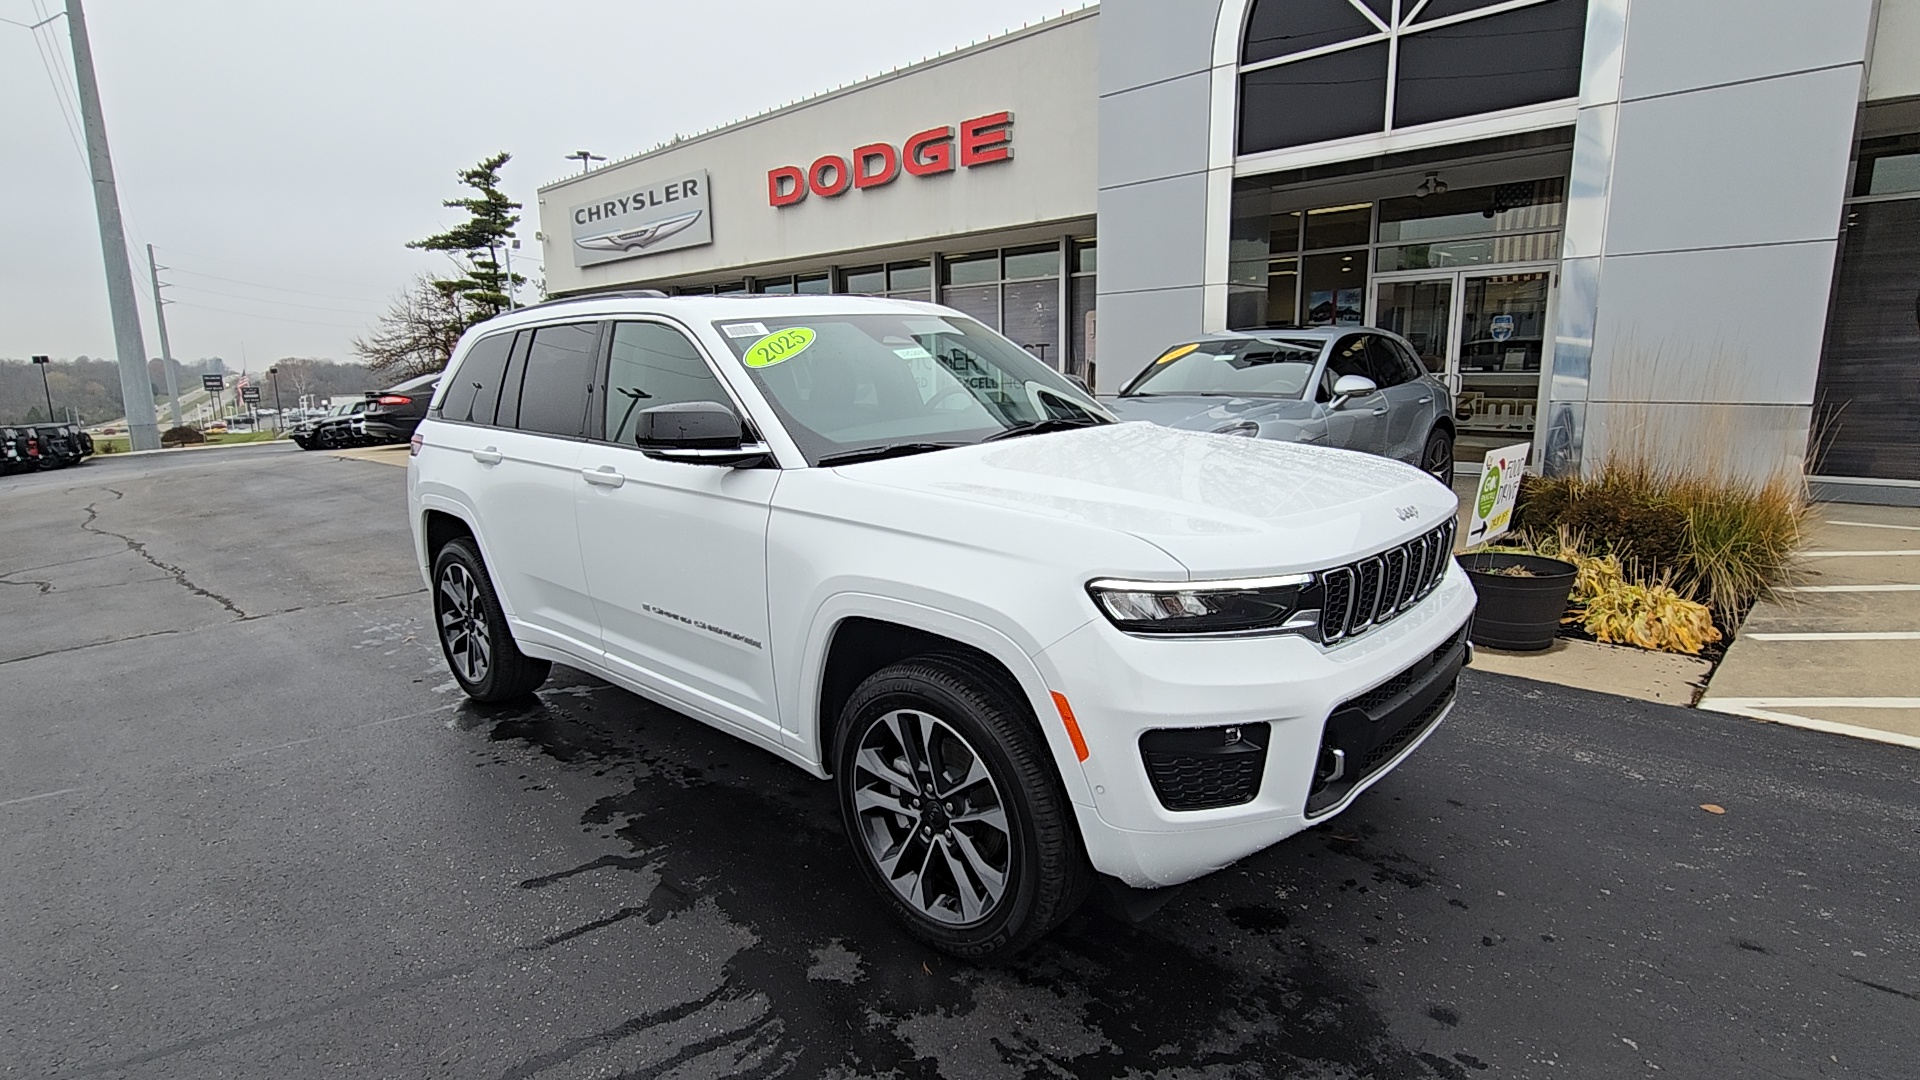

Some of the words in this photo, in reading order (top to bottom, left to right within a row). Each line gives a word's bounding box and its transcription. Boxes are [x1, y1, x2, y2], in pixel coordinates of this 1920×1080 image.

[767, 111, 1014, 207] DODGE
[574, 179, 698, 225] CHRYSLER
[757, 331, 806, 363] 2025
[1394, 505, 1419, 521] Jeep
